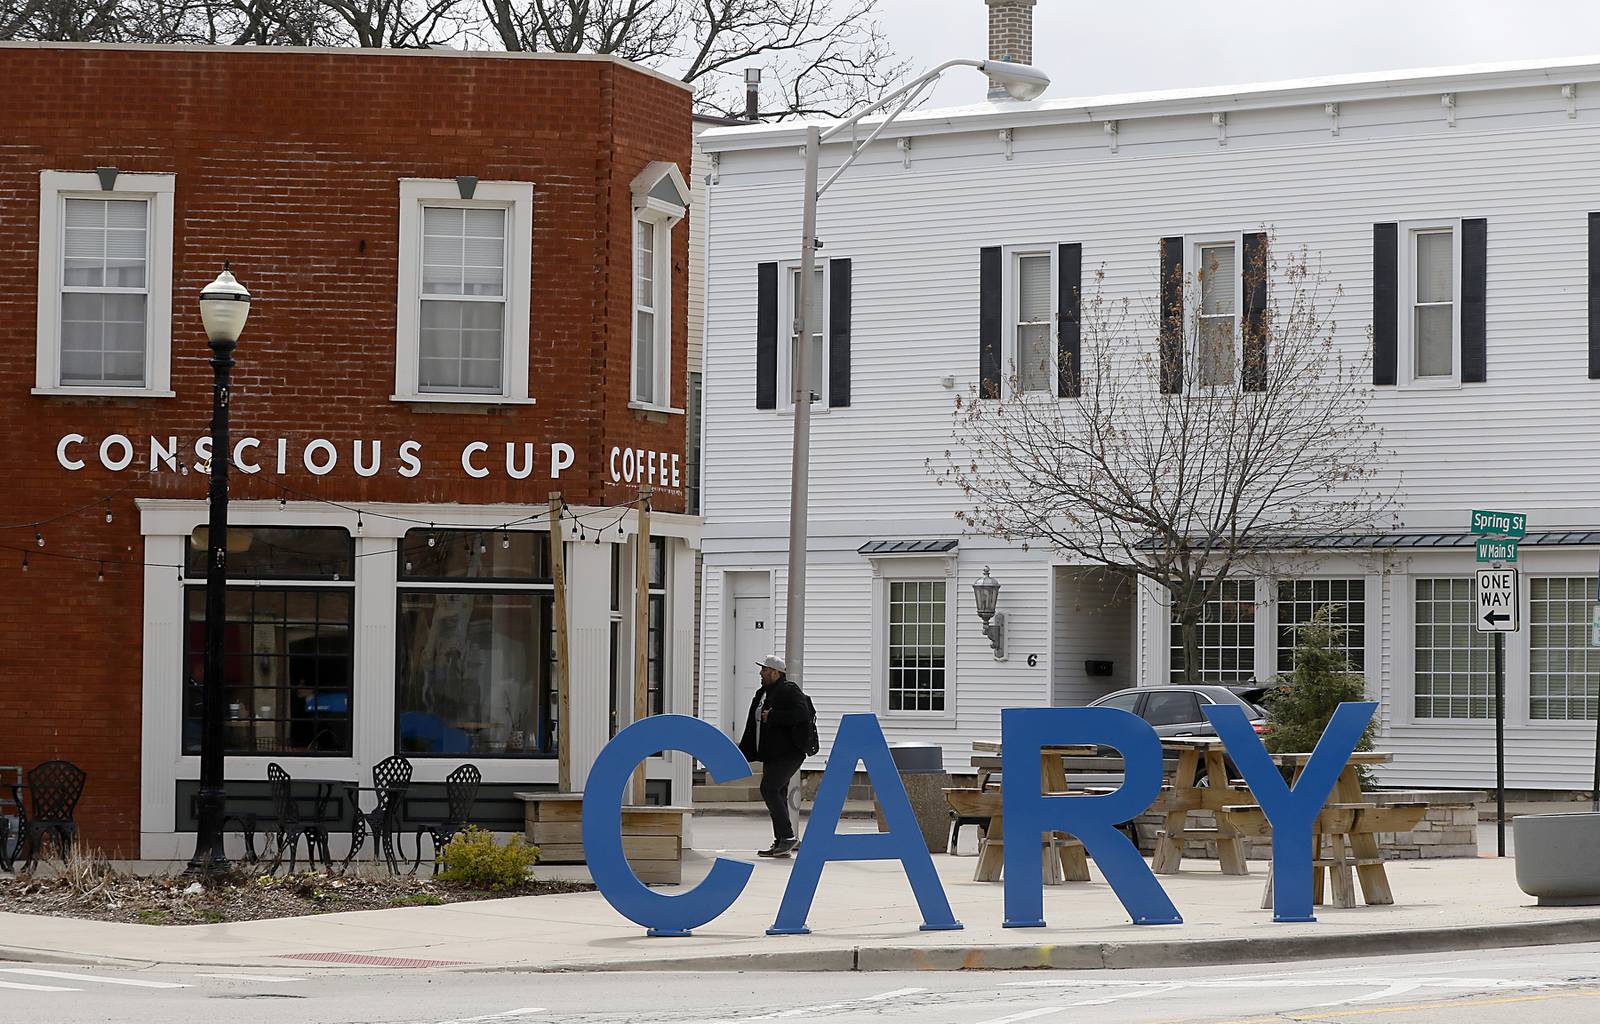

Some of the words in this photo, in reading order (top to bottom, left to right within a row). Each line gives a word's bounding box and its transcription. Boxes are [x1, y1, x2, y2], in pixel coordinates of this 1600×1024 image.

[56, 433, 422, 478] CONSCIOUS
[461, 440, 575, 479] CUP
[609, 446, 680, 487] COFFEE
[1474, 513, 1509, 532] Spring
[1512, 516, 1523, 530] St
[1479, 545, 1488, 558] W
[1488, 544, 1506, 558] Main
[1507, 544, 1515, 558] St
[1481, 575, 1510, 589] ONE
[1481, 592, 1511, 606] WAY
[1027, 653, 1038, 667] 6
[582, 701, 1379, 938] CARY
